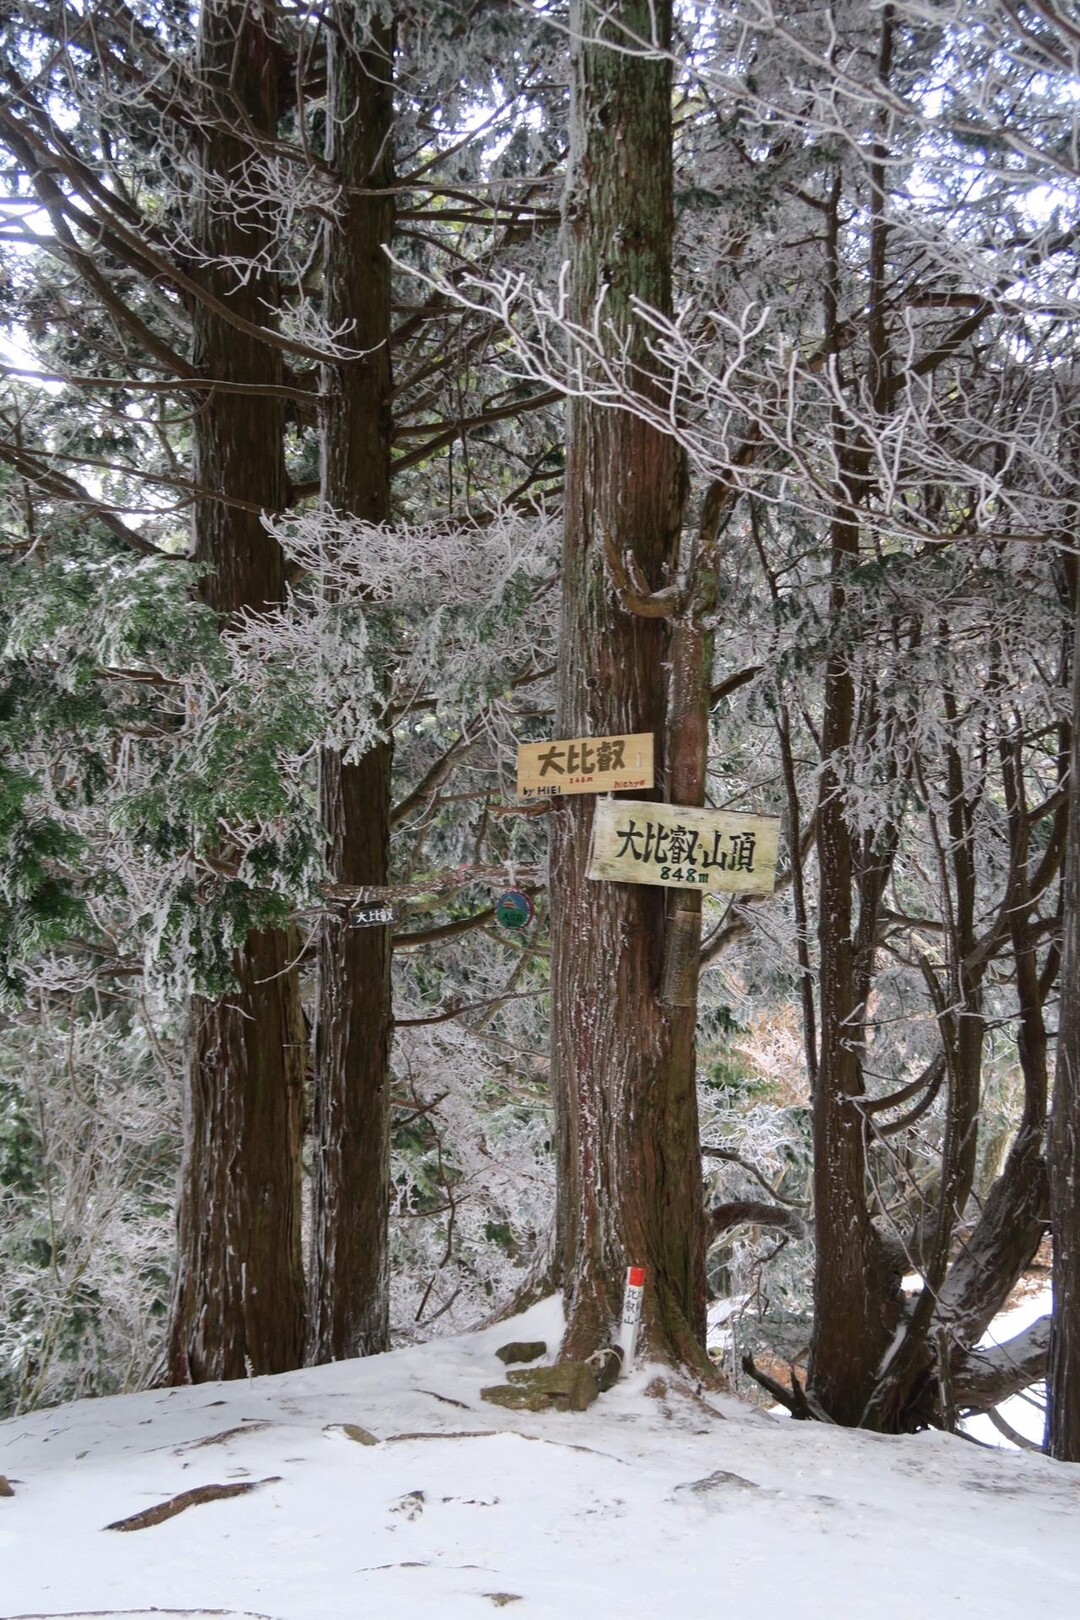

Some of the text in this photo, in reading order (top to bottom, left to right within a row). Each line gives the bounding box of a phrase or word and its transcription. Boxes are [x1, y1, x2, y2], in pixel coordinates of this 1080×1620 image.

[537, 740, 626, 777] 大比叡
[523, 785, 561, 796] by HIEI
[614, 820, 756, 873] 大比叡山頂
[660, 866, 709, 883] 848m
[624, 1288, 638, 1325] 比叡山
